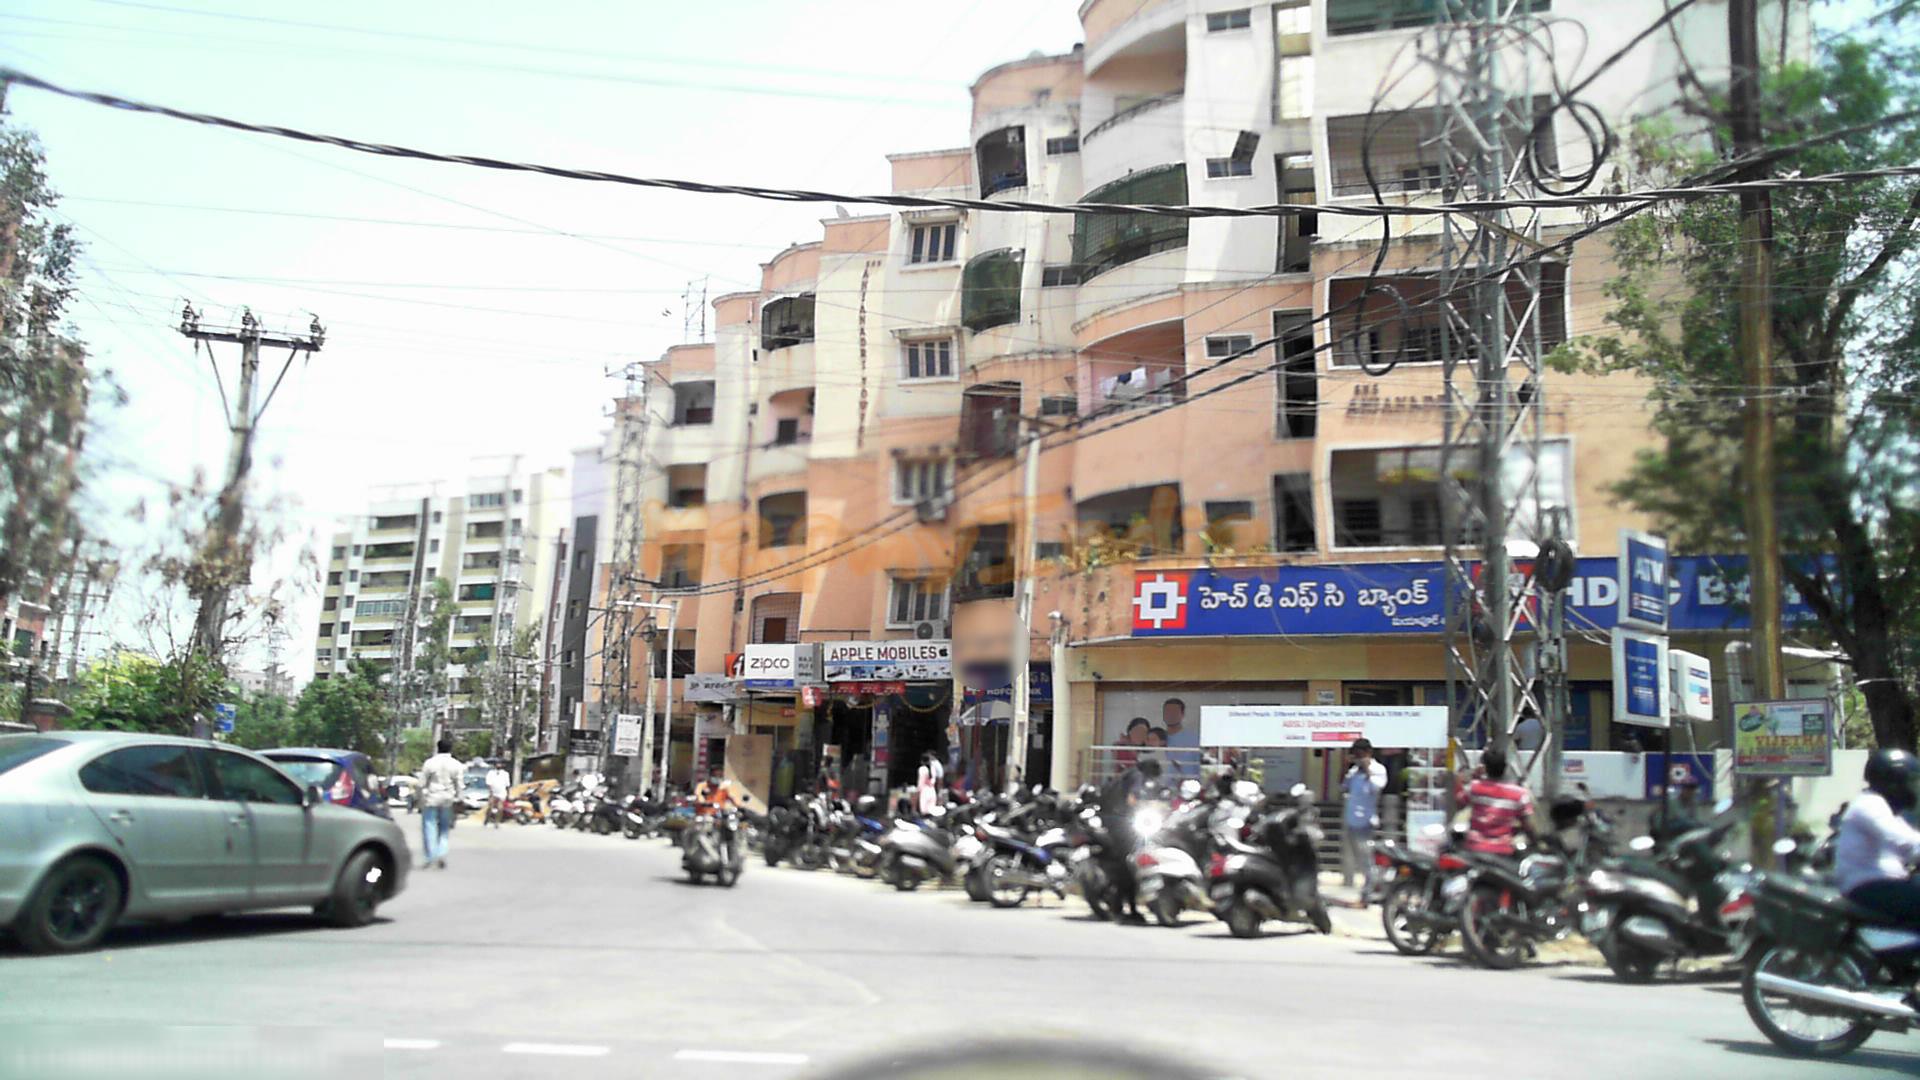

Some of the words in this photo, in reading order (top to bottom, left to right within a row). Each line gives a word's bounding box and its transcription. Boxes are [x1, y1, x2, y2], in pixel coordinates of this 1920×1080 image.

[1634, 557, 1664, 586] ATM
[831, 647, 873, 660] APPLE
[877, 646, 937, 660] MOBILES
[750, 657, 791, 674] zipco
